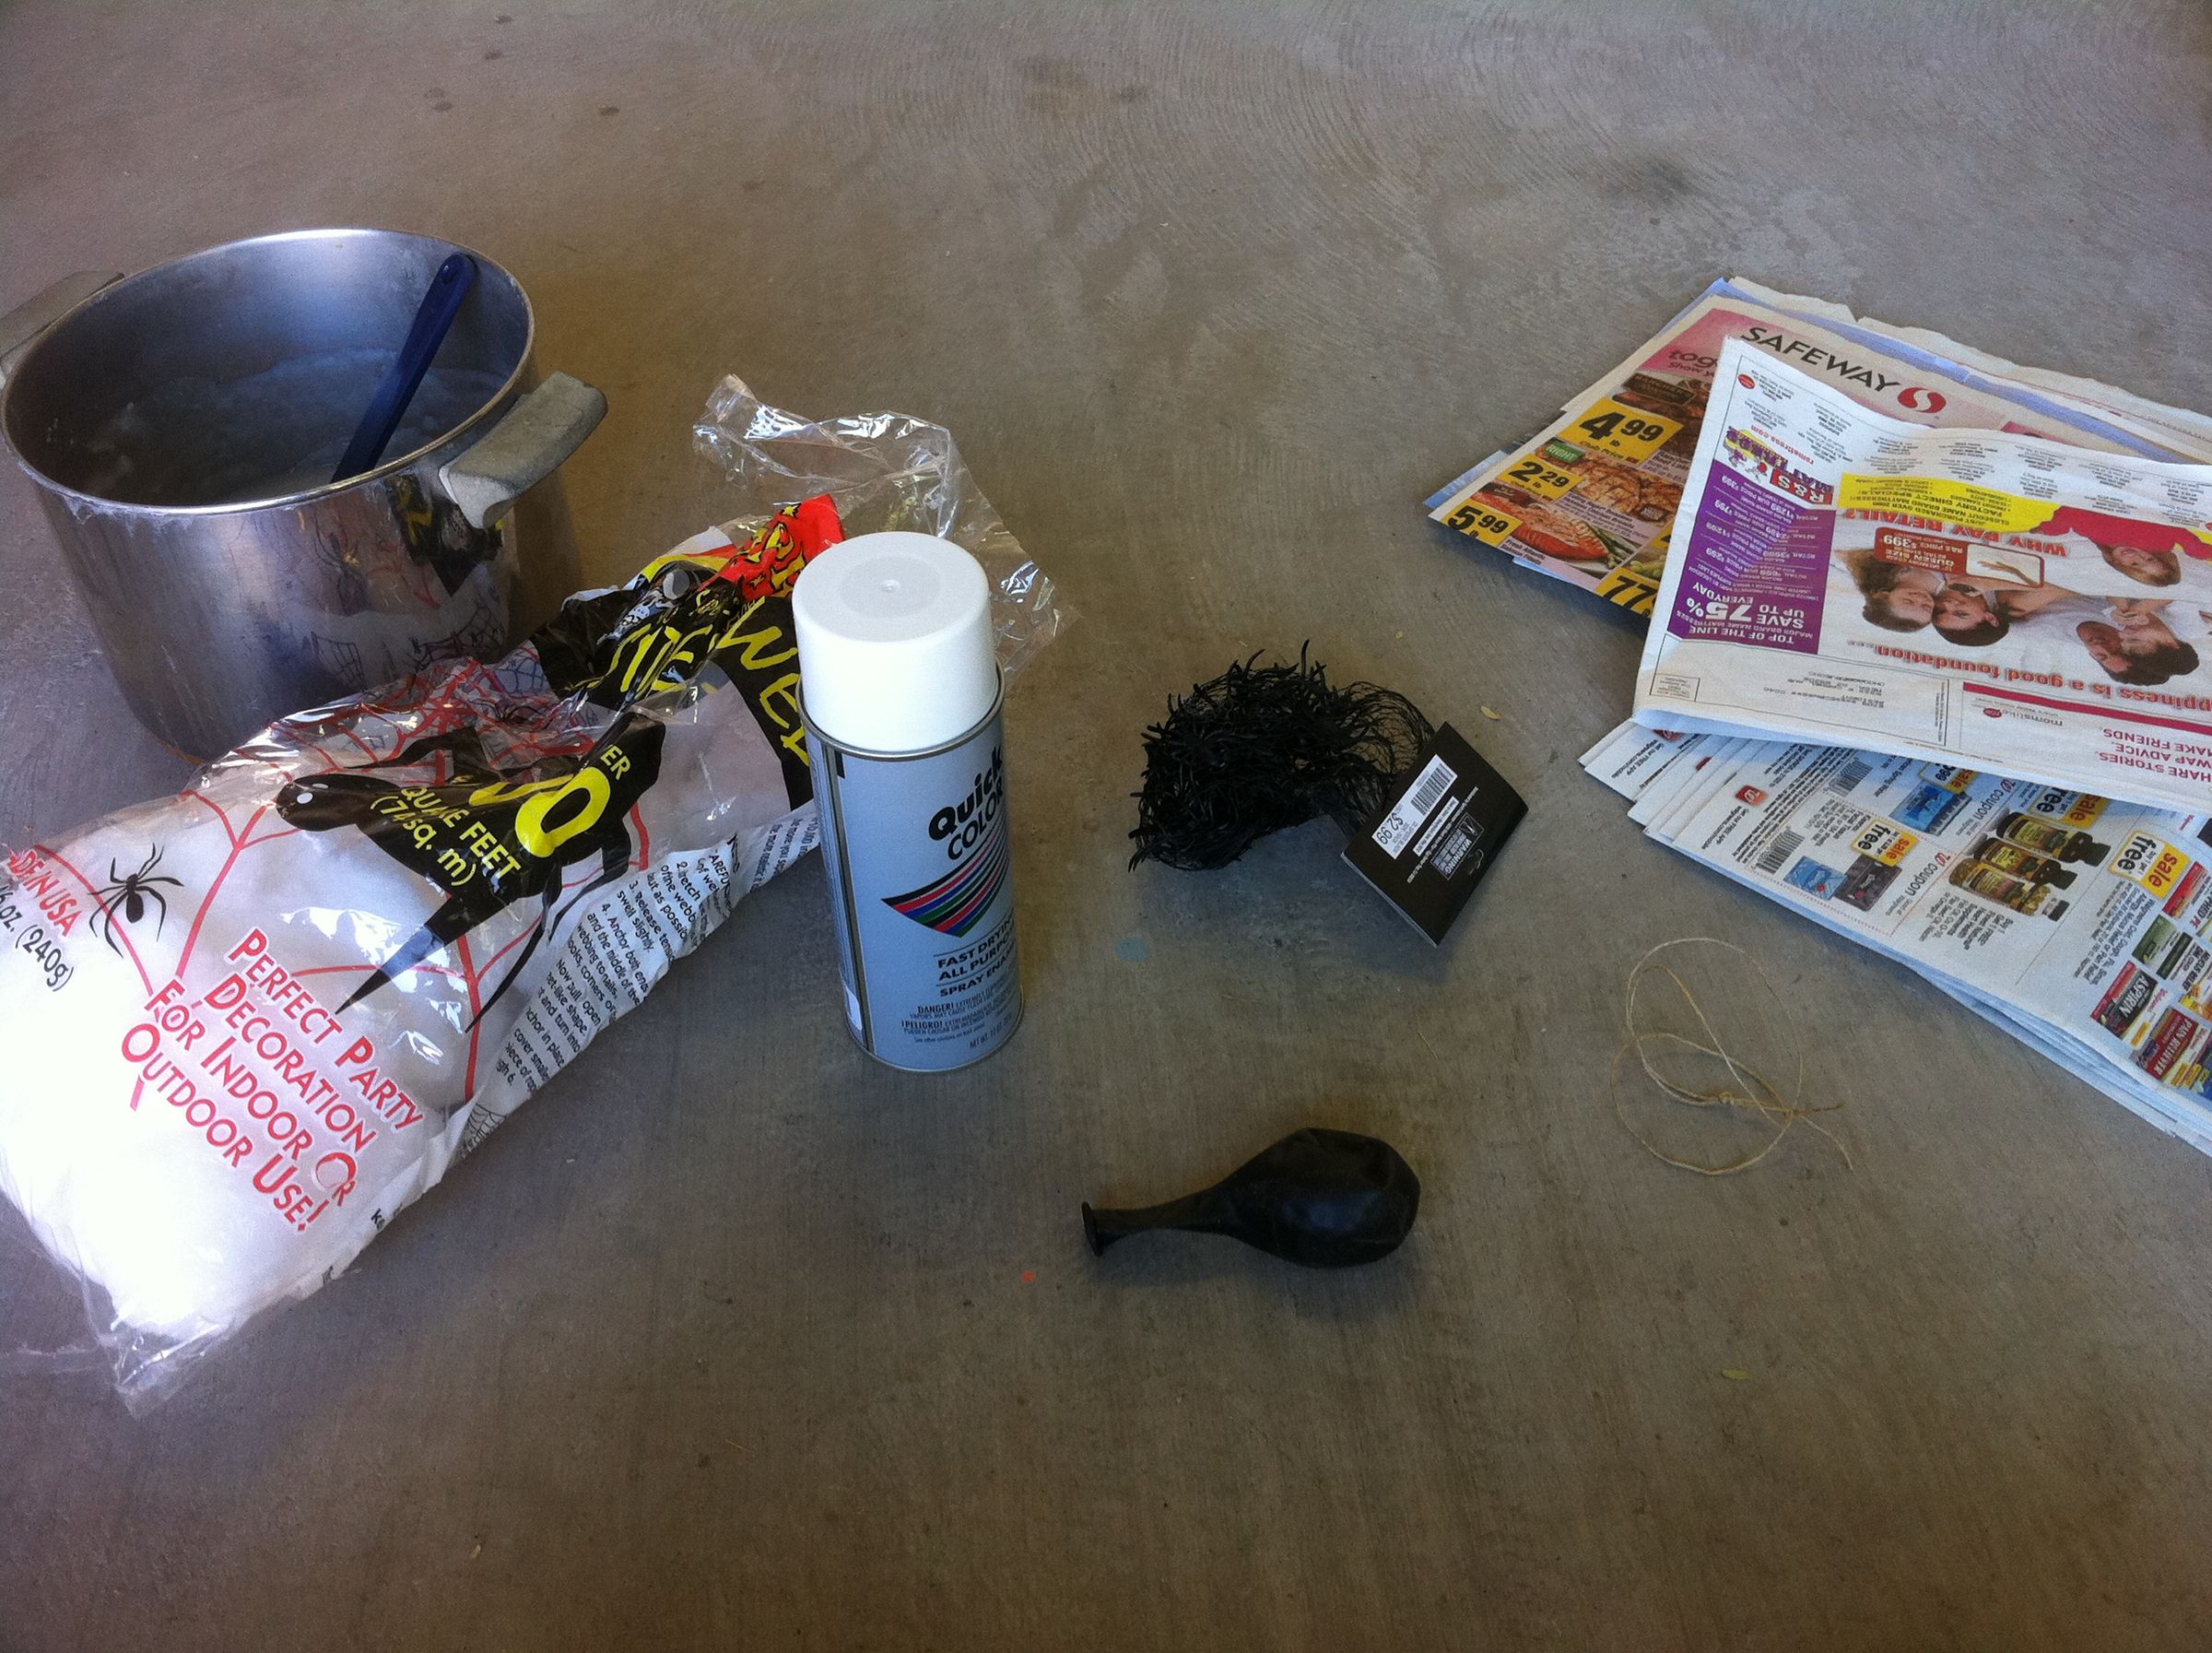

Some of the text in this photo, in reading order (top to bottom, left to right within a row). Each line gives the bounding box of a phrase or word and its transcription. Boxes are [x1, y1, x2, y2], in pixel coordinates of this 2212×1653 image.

[1739, 326, 1900, 393] SAFEWAY
[1914, 493, 2003, 516] FACTORY DIRECT
[1843, 504, 2065, 556] WHY PAY RETAIL?
[1883, 535, 1916, 549] $399
[1692, 582, 1753, 607] EVERYDAY
[1759, 604, 1779, 614] TO
[1688, 622, 1717, 633] LINE
[1756, 613, 1804, 628] SAVE
[1783, 608, 1804, 618] UP
[1721, 628, 1745, 637] THE
[1768, 633, 1794, 643] TOP
[1875, 644, 2212, 712] ppiness is a good foundation
[2102, 728, 2170, 750] FRIENDS.
[2115, 742, 2210, 769] WAP ADVICE.
[2099, 751, 2211, 782] HARE STORIES.
[928, 745, 1003, 841] Quick
[1972, 788, 2004, 820] coupon
[2036, 784, 2065, 812] ree
[460, 822, 522, 879] FEET
[1857, 823, 1890, 849] free
[1886, 834, 1910, 859] sale
[2117, 835, 2156, 869] free
[439, 849, 477, 886] m)
[1445, 839, 1473, 874] WARNING
[2146, 850, 2157, 859] buy
[2147, 852, 2177, 887] sale
[1904, 862, 1937, 895] coupon
[39, 888, 83, 938] USA
[629, 880, 661, 934] 3. Release
[653, 891, 665, 903] as
[617, 890, 653, 950] swell slightly.
[1947, 903, 1977, 936] Supplements
[15, 924, 75, 992] (240g)
[576, 923, 599, 963] webbing
[595, 961, 605, 974] to
[586, 913, 603, 932] and
[596, 931, 610, 950] the
[606, 949, 626, 979] middle
[620, 978, 632, 989] of
[606, 916, 629, 949] Anchor
[625, 950, 641, 971] both
[937, 918, 1014, 969] FAST DRYIN
[938, 931, 1012, 982] ALL PURPO
[556, 959, 571, 981] Now
[582, 1000, 601, 1026] open
[581, 965, 605, 1001] corners
[939, 975, 983, 998] SPRAY
[2118, 974, 2148, 1017] ASPIRIN
[229, 928, 423, 1129] PERFECT PARTY
[524, 1008, 545, 1033] nchor
[541, 1032, 551, 1045] in
[540, 996, 581, 1053] and turn into
[566, 1004, 586, 1036] shape.
[513, 1028, 532, 1054] cover
[145, 979, 206, 1050] FOR
[201, 1036, 312, 1160] INDOOR
[204, 974, 377, 1152] DECORATION
[519, 1066, 531, 1078] of
[122, 1023, 253, 1167] OUTDOOR
